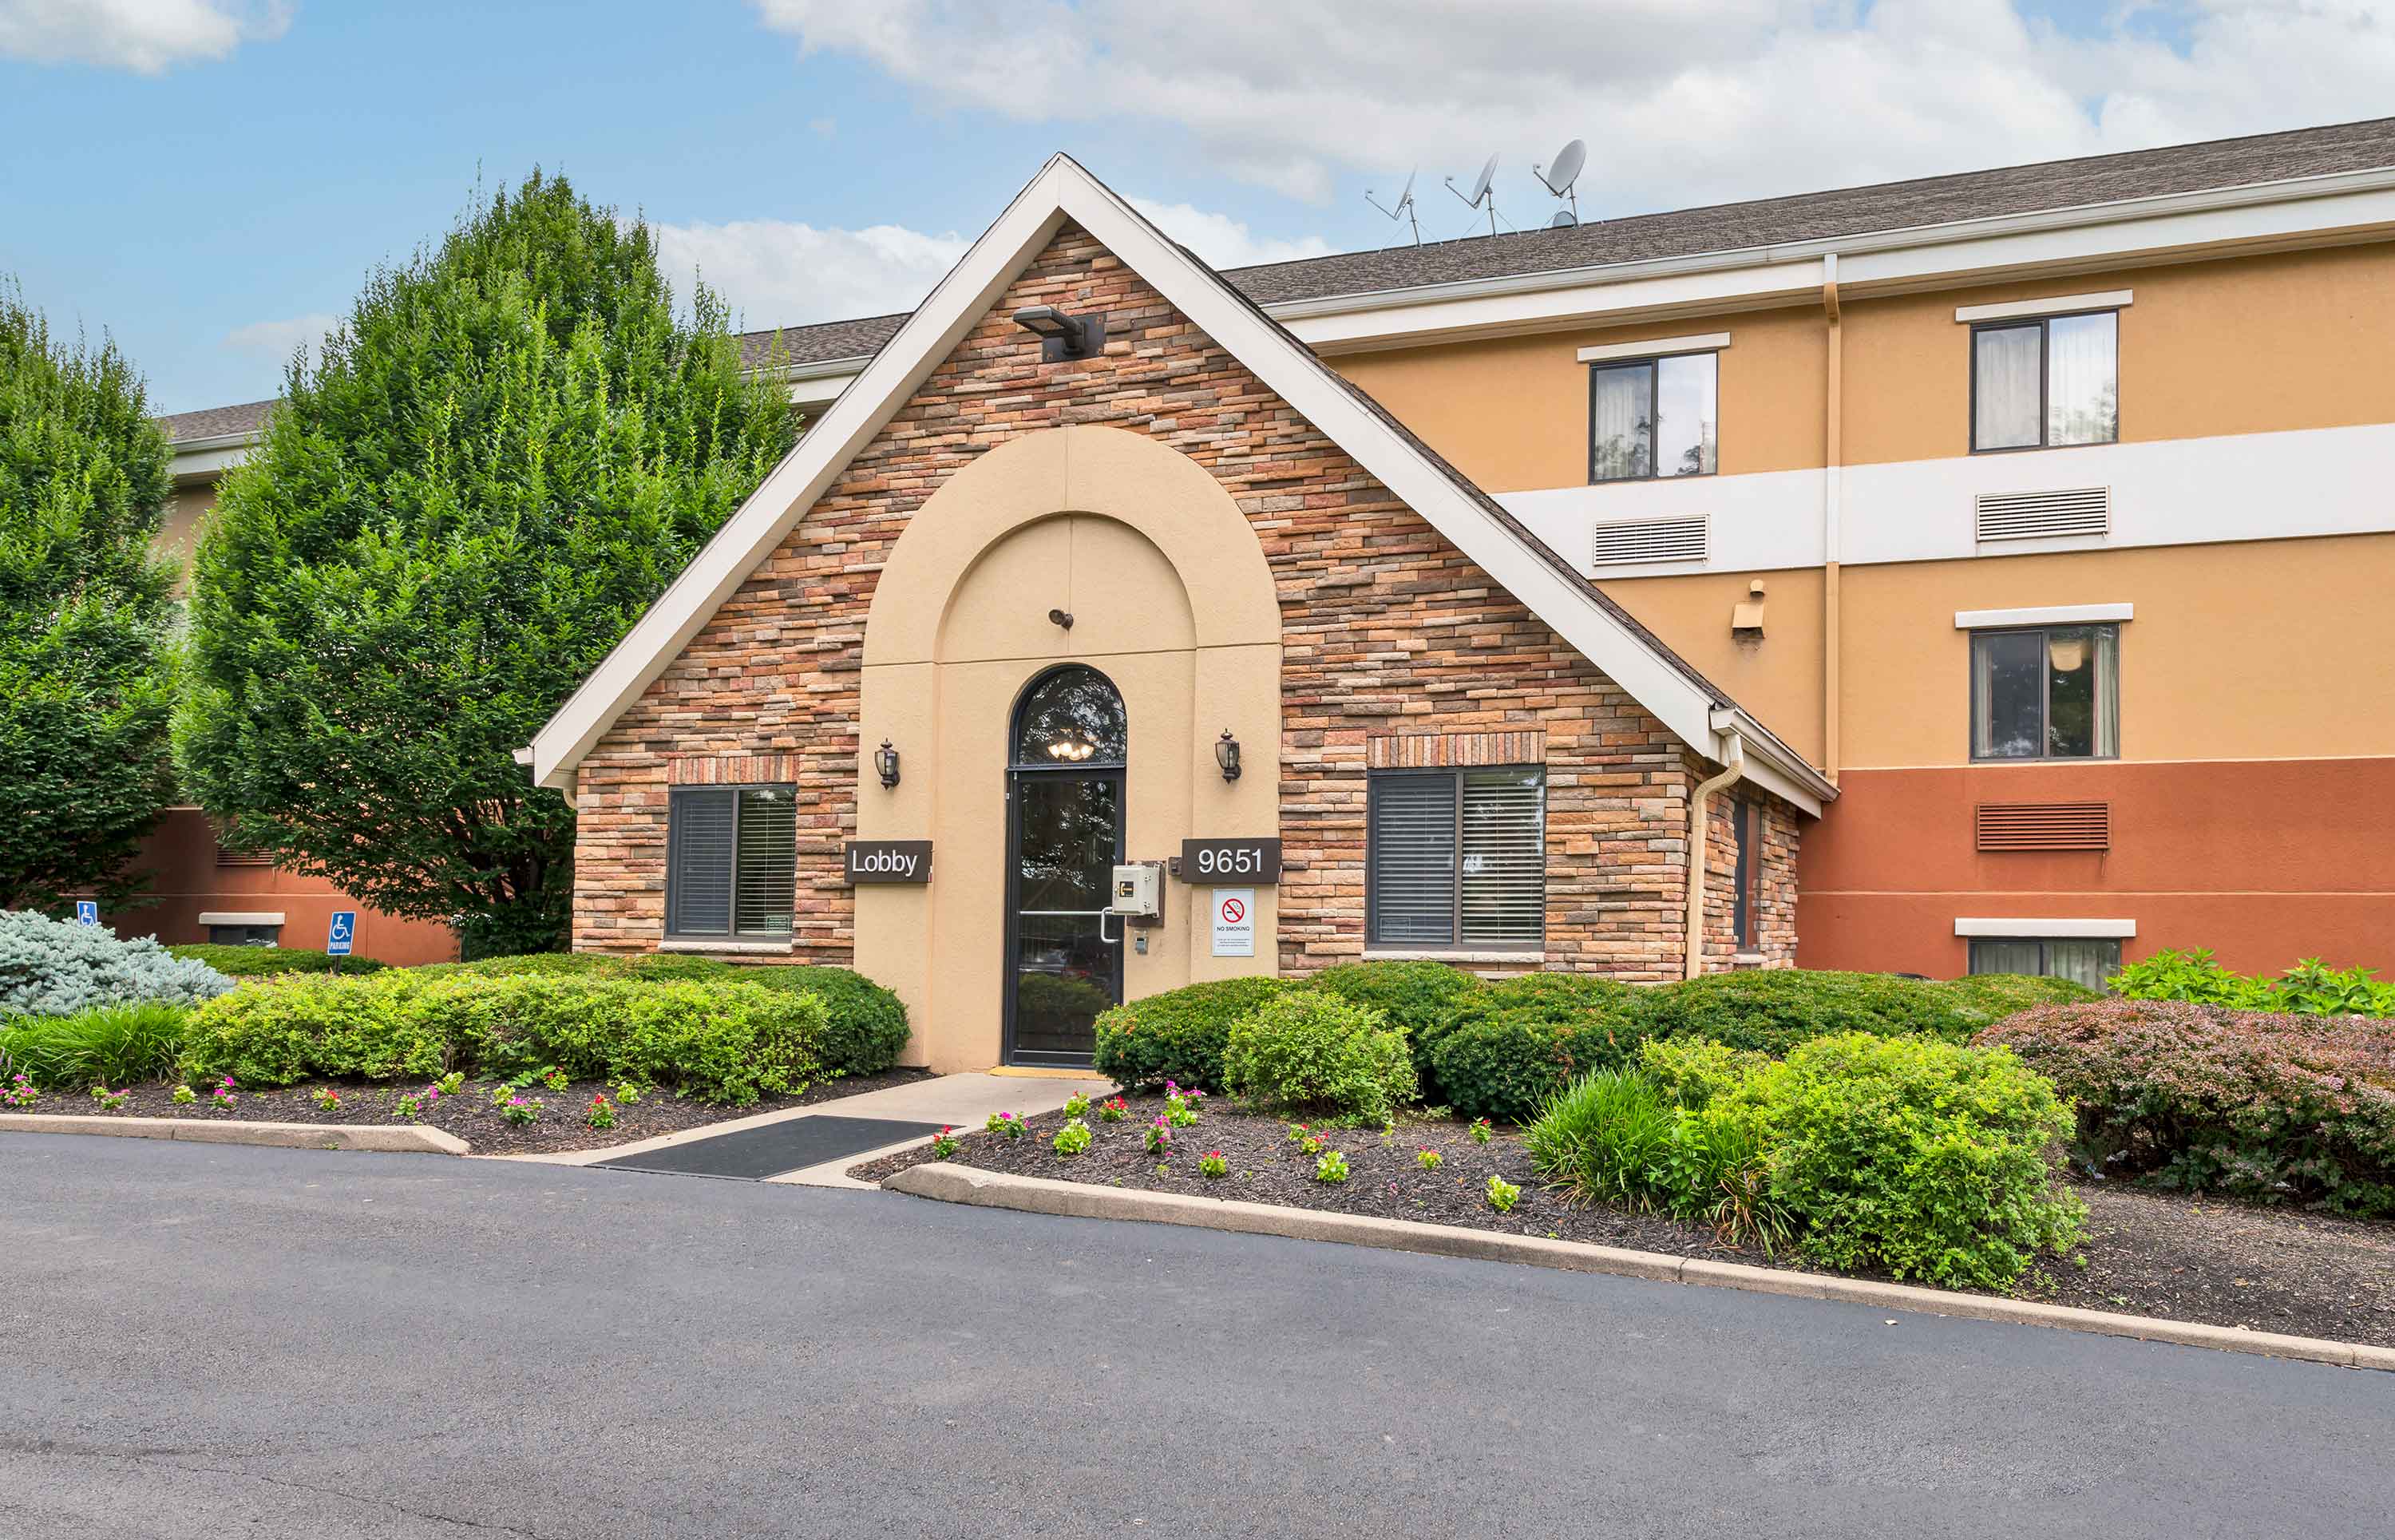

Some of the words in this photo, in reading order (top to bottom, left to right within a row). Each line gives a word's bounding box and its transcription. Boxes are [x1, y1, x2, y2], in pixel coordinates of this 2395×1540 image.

[853, 849, 917, 877] Lobby
[1198, 848, 1261, 873] 9651
[330, 941, 350, 950] PARKING
